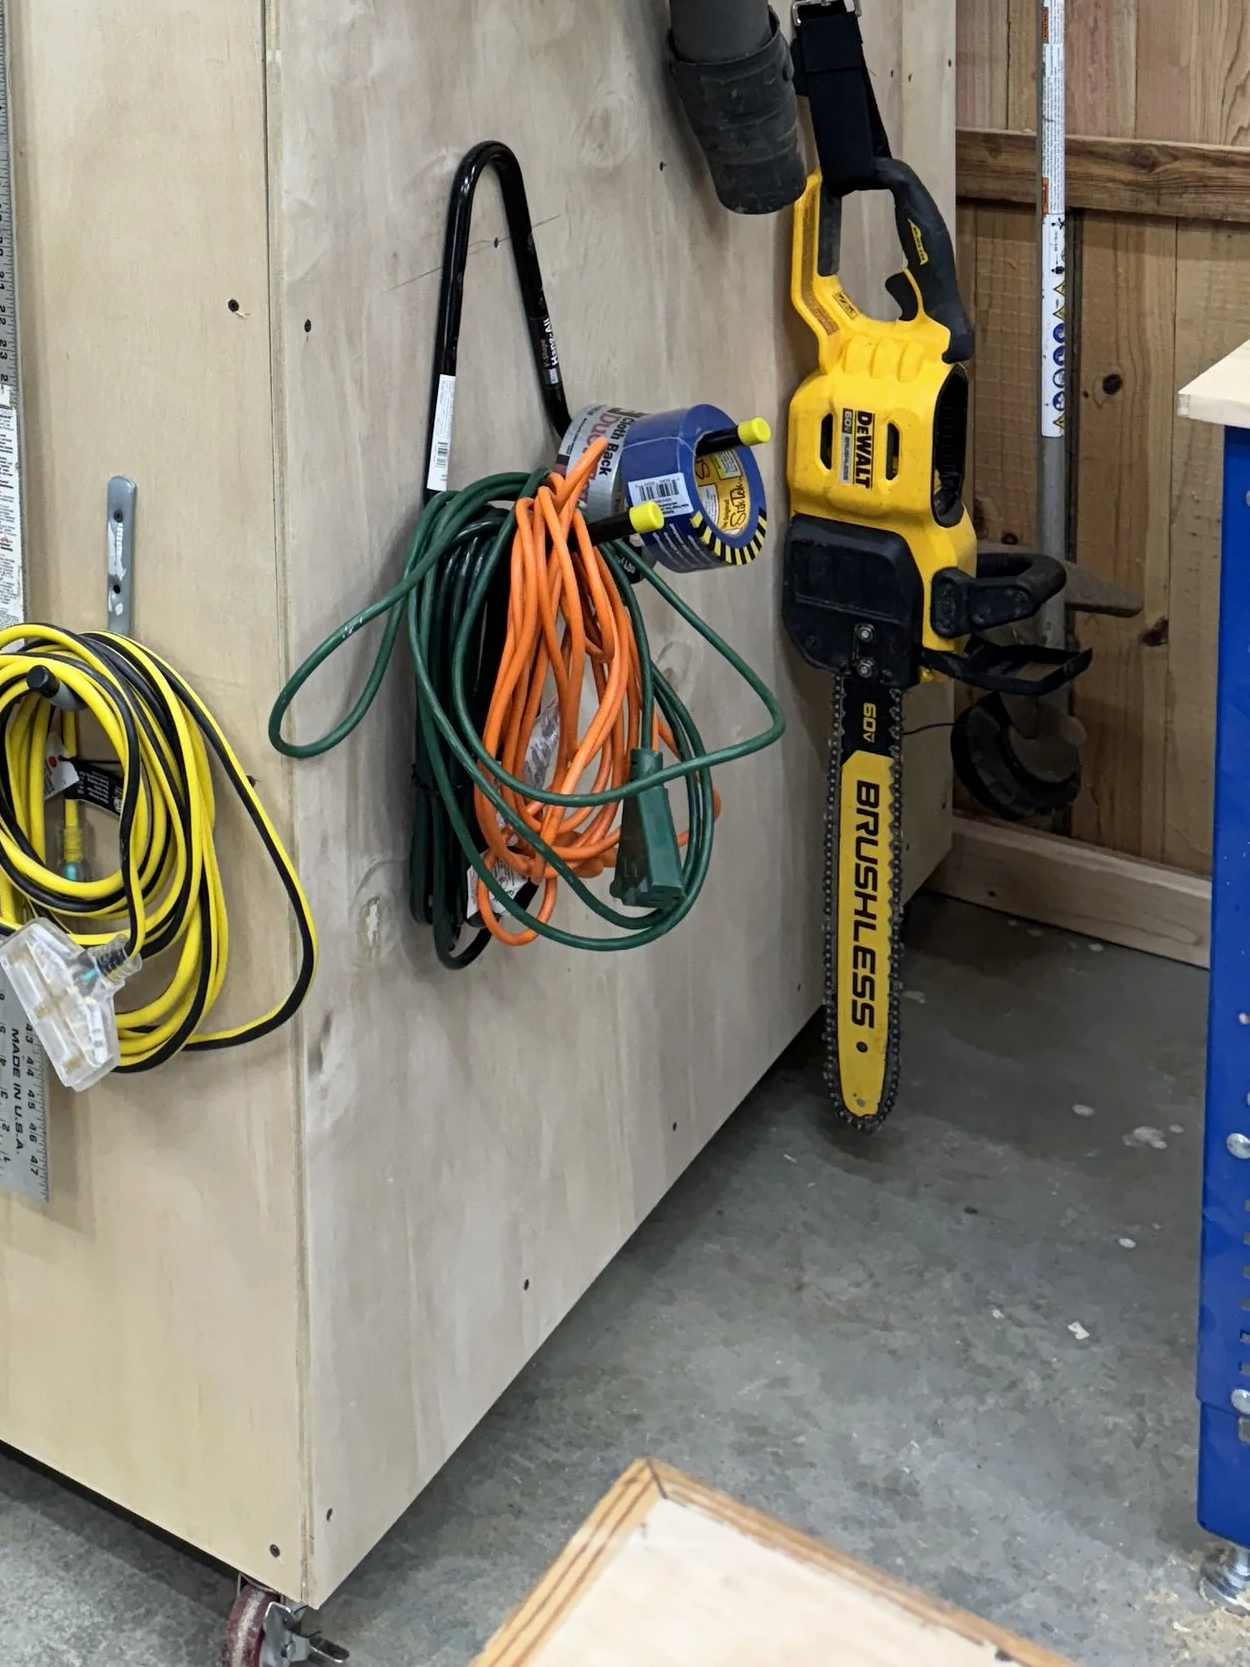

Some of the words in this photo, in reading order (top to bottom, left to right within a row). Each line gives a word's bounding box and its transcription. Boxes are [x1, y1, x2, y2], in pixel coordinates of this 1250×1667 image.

[611, 417, 635, 442] Cloth
[855, 410, 873, 490] DEWALT
[598, 443, 620, 477] Back
[851, 779, 880, 1031] BRUSHLESS
[10, 1028, 22, 1079] MADE
[12, 1082, 22, 1101] IN
[13, 1105, 25, 1155] U.S.A.
